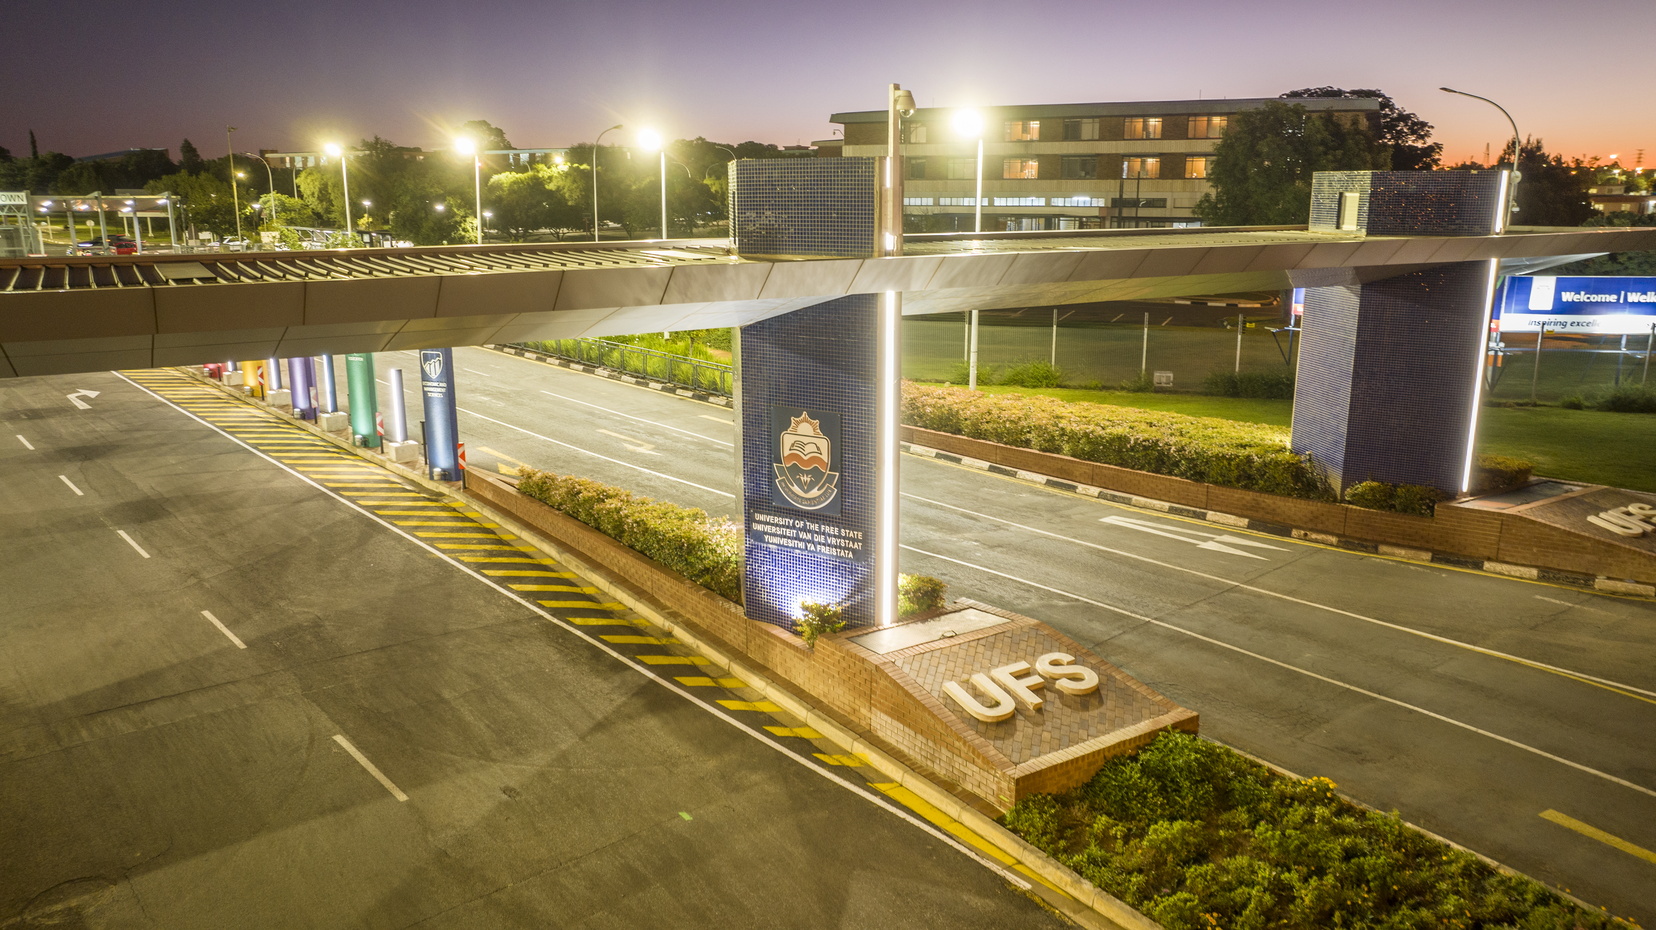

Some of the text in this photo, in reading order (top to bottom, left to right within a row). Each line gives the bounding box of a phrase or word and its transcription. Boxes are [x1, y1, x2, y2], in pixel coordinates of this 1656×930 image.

[1561, 291, 1618, 303] Welcome
[1619, 290, 1626, 304] /
[1528, 318, 1568, 329] inspiring
[754, 513, 863, 540] UNIVERSITY OF THE FREE STATE
[1587, 502, 1656, 538] UFS
[752, 522, 863, 551] UNIVERSITEIT VAN DIE VRYSTAAT
[763, 534, 854, 559] YUNIVESITHI YA FREISTATA
[942, 651, 1099, 723] UFS
